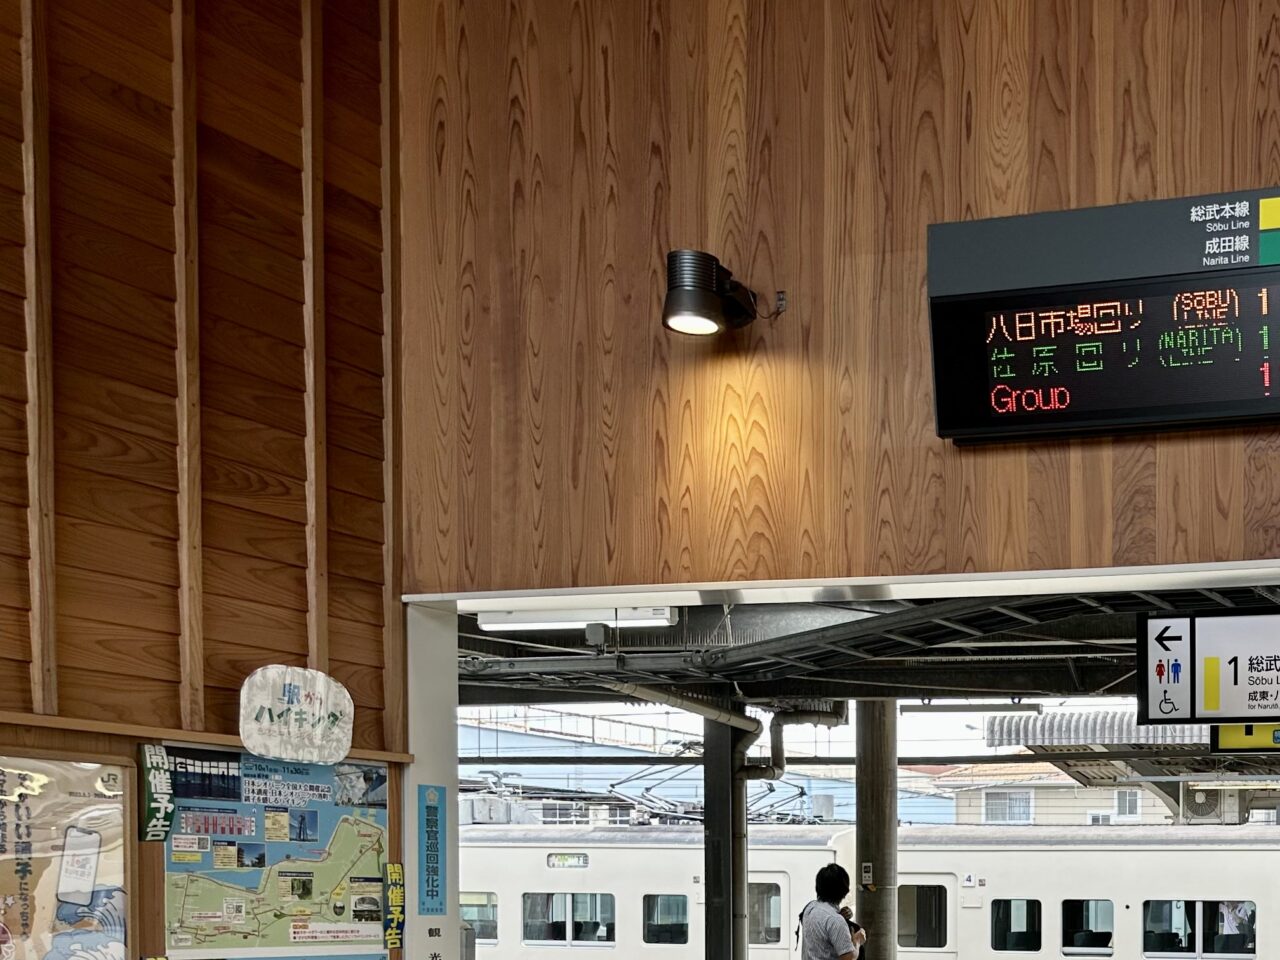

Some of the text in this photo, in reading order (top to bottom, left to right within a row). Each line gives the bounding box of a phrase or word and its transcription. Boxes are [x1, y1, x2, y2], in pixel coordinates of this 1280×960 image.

[1190, 201, 1250, 223] 総武本線
[1232, 220, 1250, 230] Line
[1205, 235, 1250, 254] 成田線
[1203, 253, 1250, 266] Narita Line
[1228, 656, 1239, 686] 1
[101, 773, 118, 784] JR
[144, 744, 175, 840] 開催予告
[964, 874, 972, 883] 4
[384, 863, 404, 949] 開催予告
